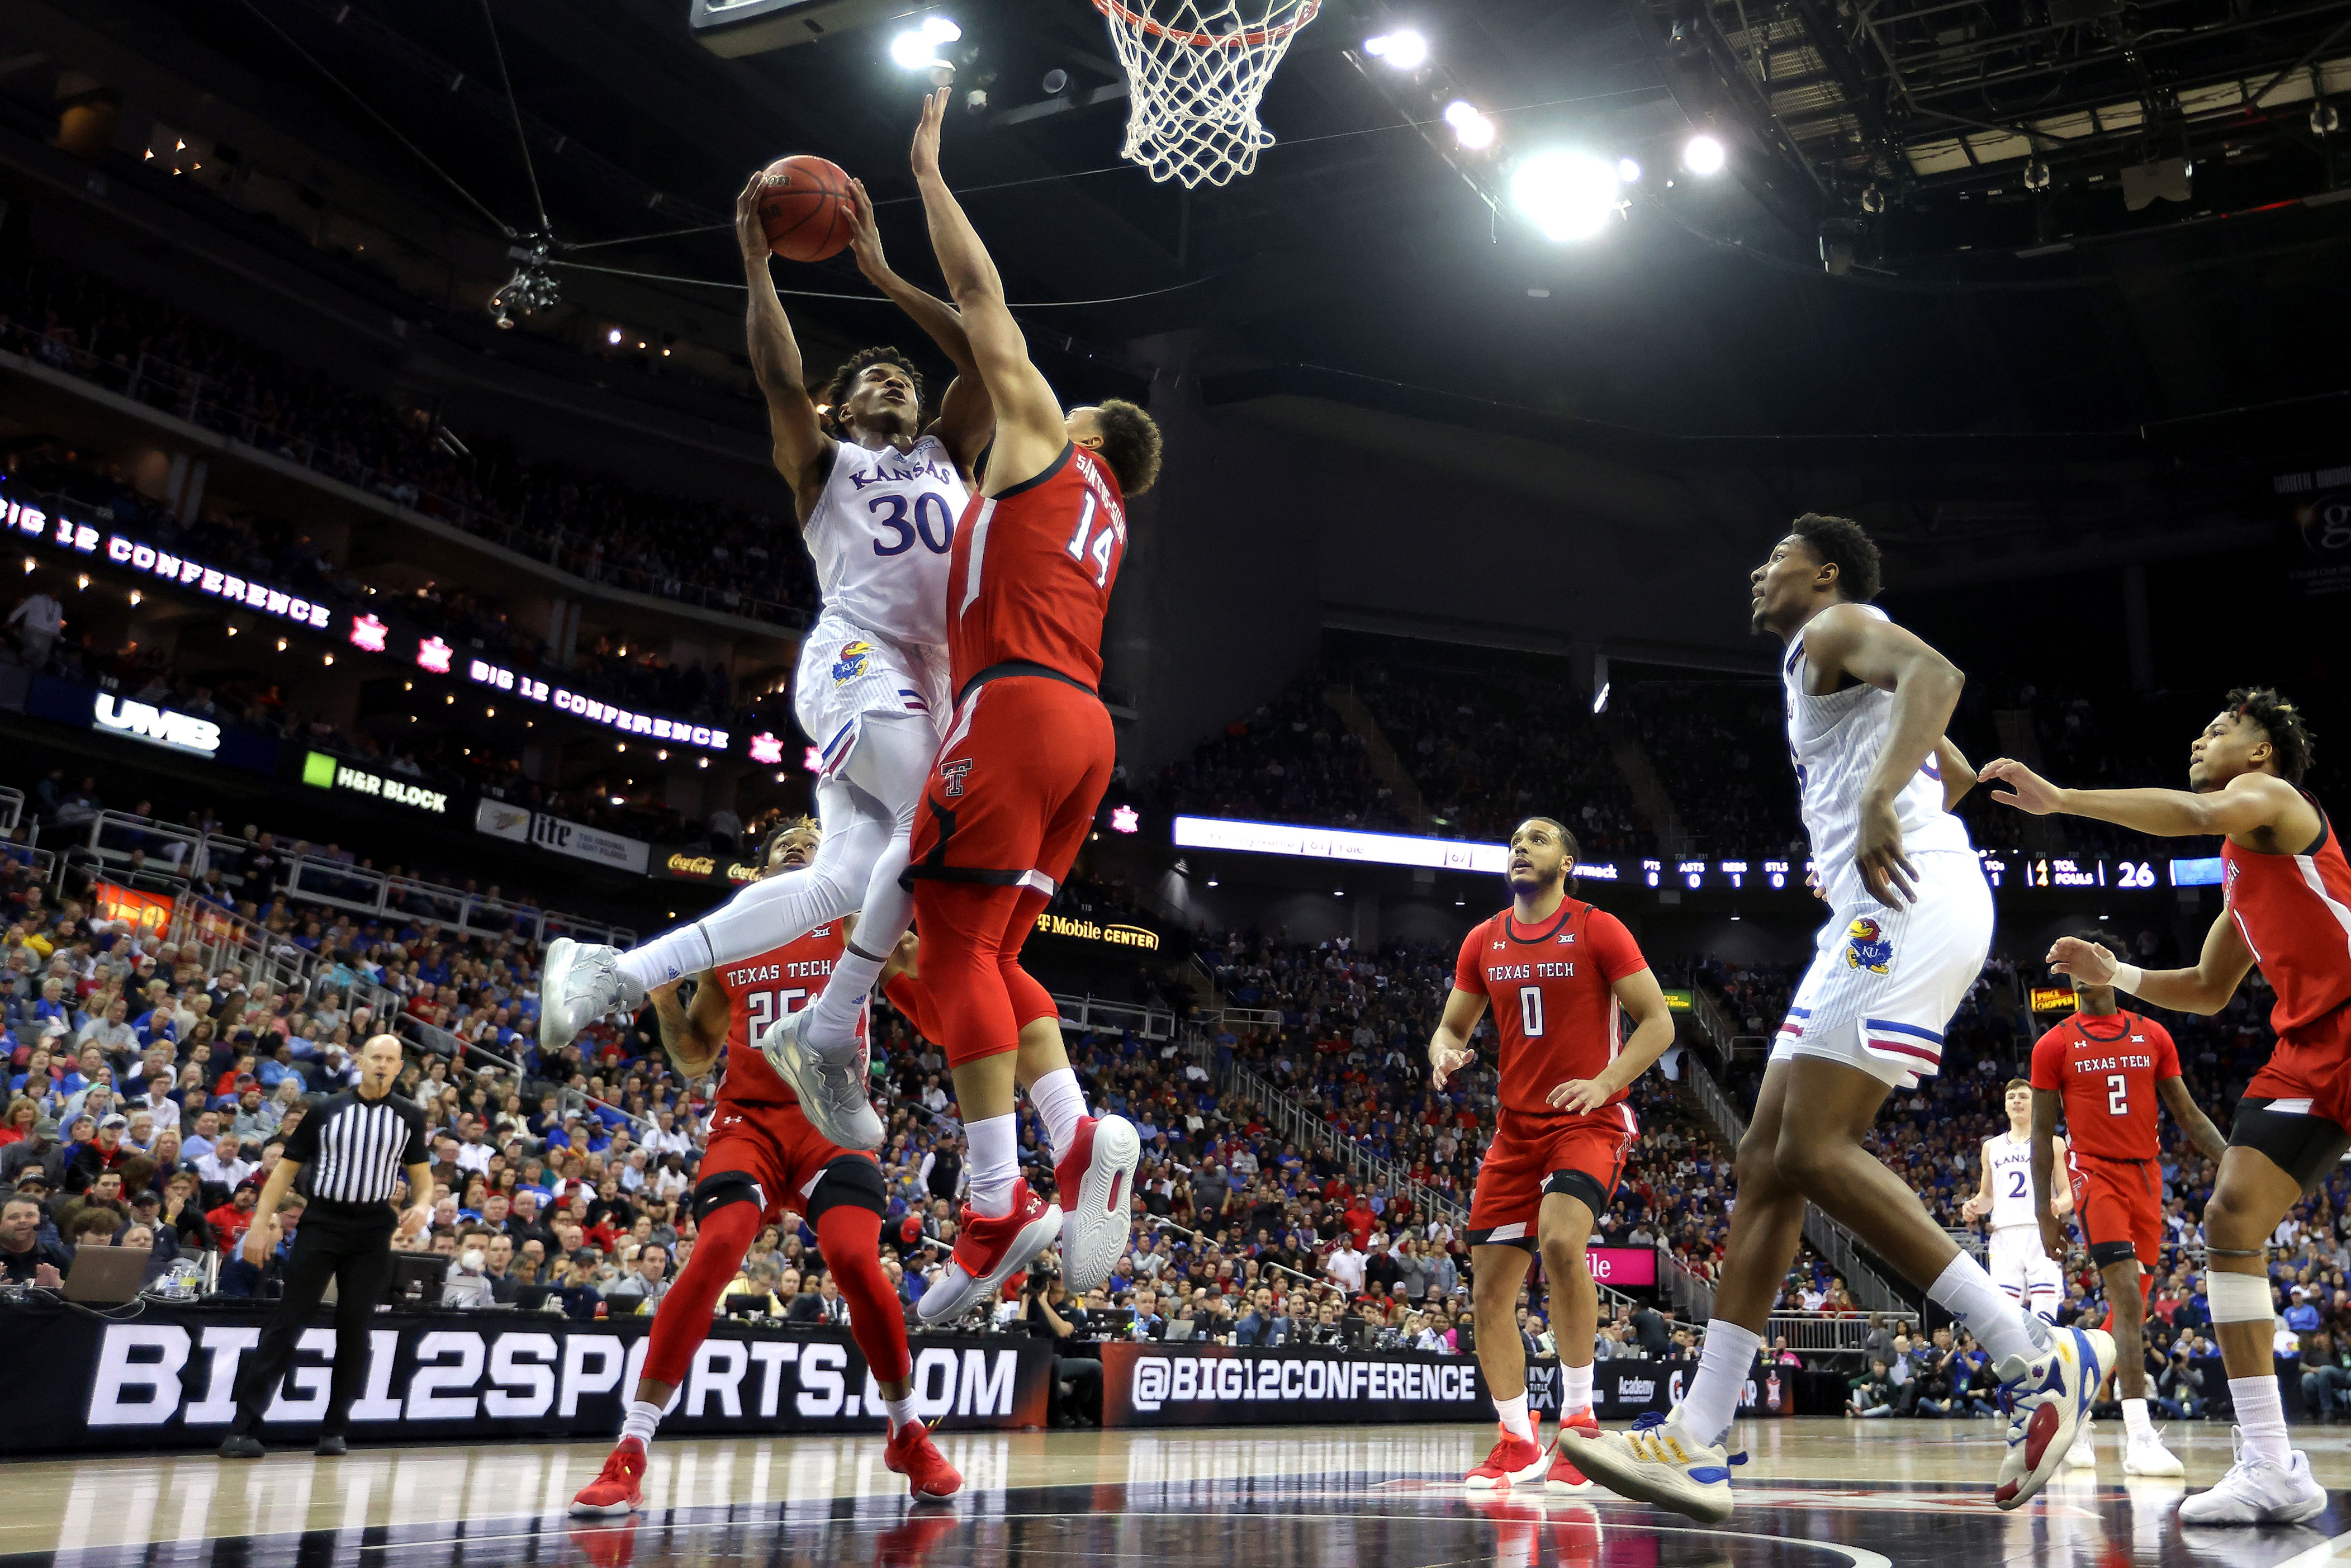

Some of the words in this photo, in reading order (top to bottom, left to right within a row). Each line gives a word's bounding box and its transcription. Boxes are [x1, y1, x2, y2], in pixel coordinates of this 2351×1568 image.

[849, 461, 951, 491] KANSAS
[1075, 453, 1125, 546] SANTOS-SILVA
[869, 492, 955, 556] 30
[1066, 487, 1116, 590] 14
[55, 515, 101, 553] 12
[108, 536, 332, 628] CONFERENCE
[470, 660, 514, 691] BIG
[520, 676, 549, 702] 12
[554, 689, 730, 750] CONFERENCE
[94, 691, 221, 752] UMB
[337, 768, 381, 797] H&R
[383, 779, 447, 814] BLOCK
[1643, 860, 1661, 871] PTS
[1680, 862, 1705, 872] ASTS
[1722, 862, 1747, 872] REBS
[1765, 862, 1789, 872] STLS
[1648, 873, 1658, 887] 8
[1689, 874, 1701, 888] 0
[1733, 874, 1742, 888] 1
[1773, 874, 1785, 888] 0
[1991, 872, 2000, 886] 1
[2035, 859, 2048, 872] 4
[2053, 860, 2078, 871] TOL
[2036, 872, 2049, 887] 4
[2055, 873, 2094, 885] FOULS
[2118, 861, 2155, 888] 26
[1051, 915, 1101, 940] Mobile
[1103, 928, 1155, 949] CENTER
[1862, 945, 1879, 959] KU
[727, 964, 780, 987] TEXAS
[787, 959, 832, 978] TECH
[1488, 964, 1531, 982] TEXAS
[1537, 963, 1574, 977] TECH
[748, 988, 807, 1049] 25
[1519, 986, 1543, 1037] 0
[2074, 1057, 2116, 1073] TEXAS
[2120, 1055, 2150, 1068] TECH
[2107, 1074, 2128, 1115] 2
[1994, 1153, 2031, 1169] KANSA
[2009, 1171, 2027, 1198] 2
[1131, 1356, 1476, 1411] @BIG12CONFERENCE
[1619, 1375, 1656, 1398] Academy
[1669, 1370, 1684, 1407] G
[1739, 1379, 1757, 1407] UP
